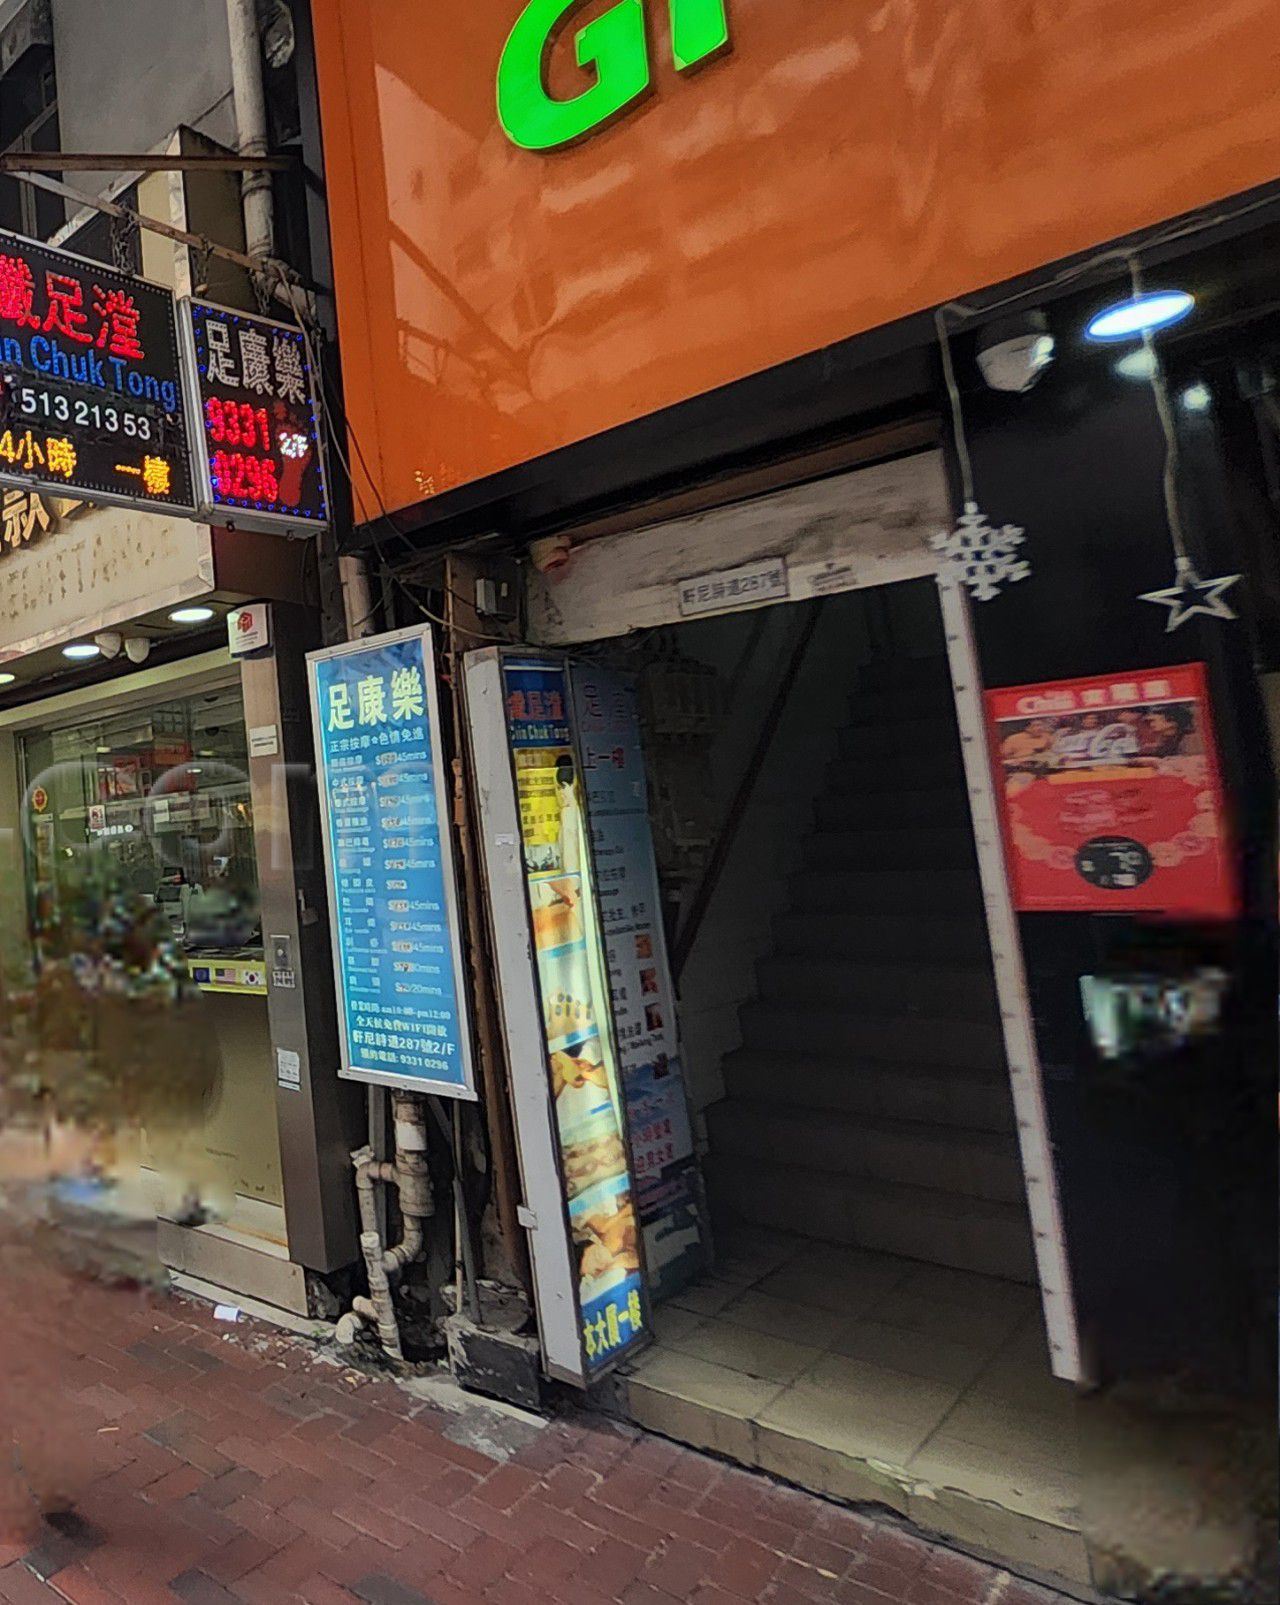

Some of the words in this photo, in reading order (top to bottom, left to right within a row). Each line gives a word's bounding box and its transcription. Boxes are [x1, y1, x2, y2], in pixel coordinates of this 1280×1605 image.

[30, 335, 105, 387] Chuk
[108, 356, 177, 414] Tong
[206, 319, 306, 405] 足康樂
[328, 666, 424, 732] 足康樂
